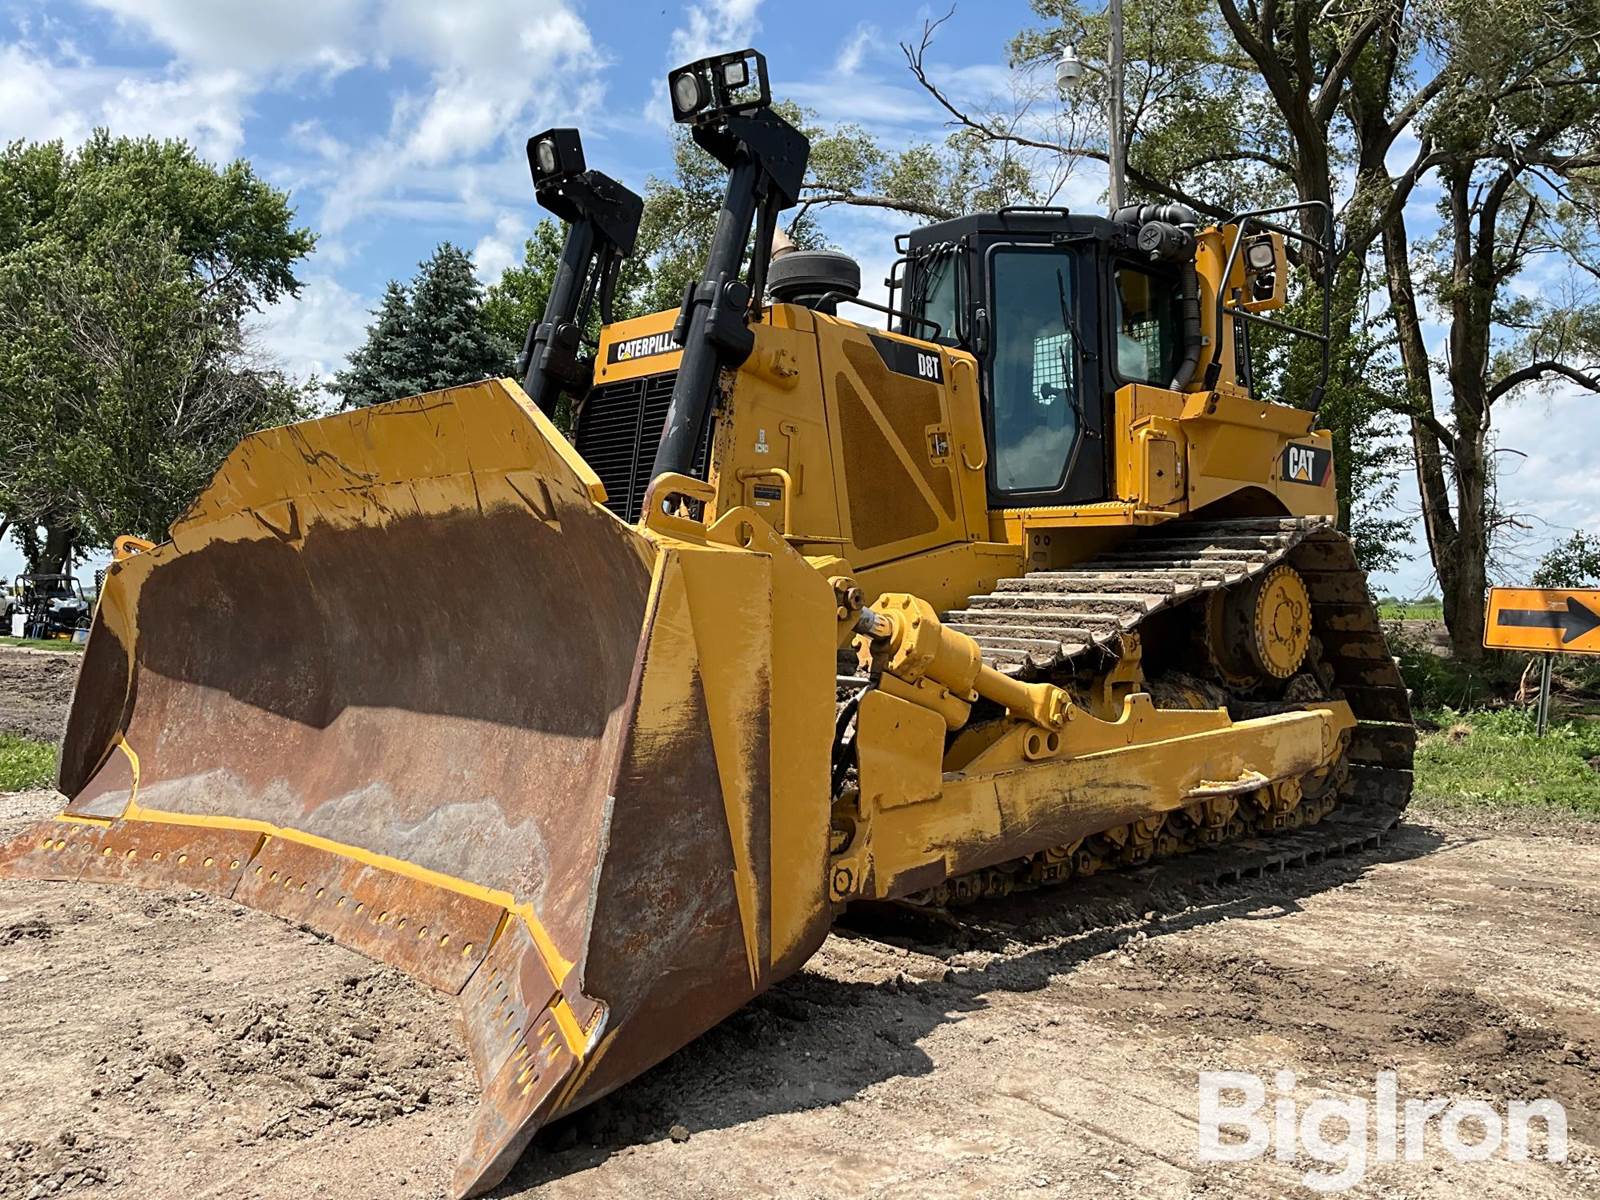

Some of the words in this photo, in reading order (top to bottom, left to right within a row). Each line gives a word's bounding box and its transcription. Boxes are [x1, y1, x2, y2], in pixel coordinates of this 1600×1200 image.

[617, 333, 682, 361] CATERPILLA
[917, 352, 939, 379] D8T
[1289, 446, 1315, 481] CAT
